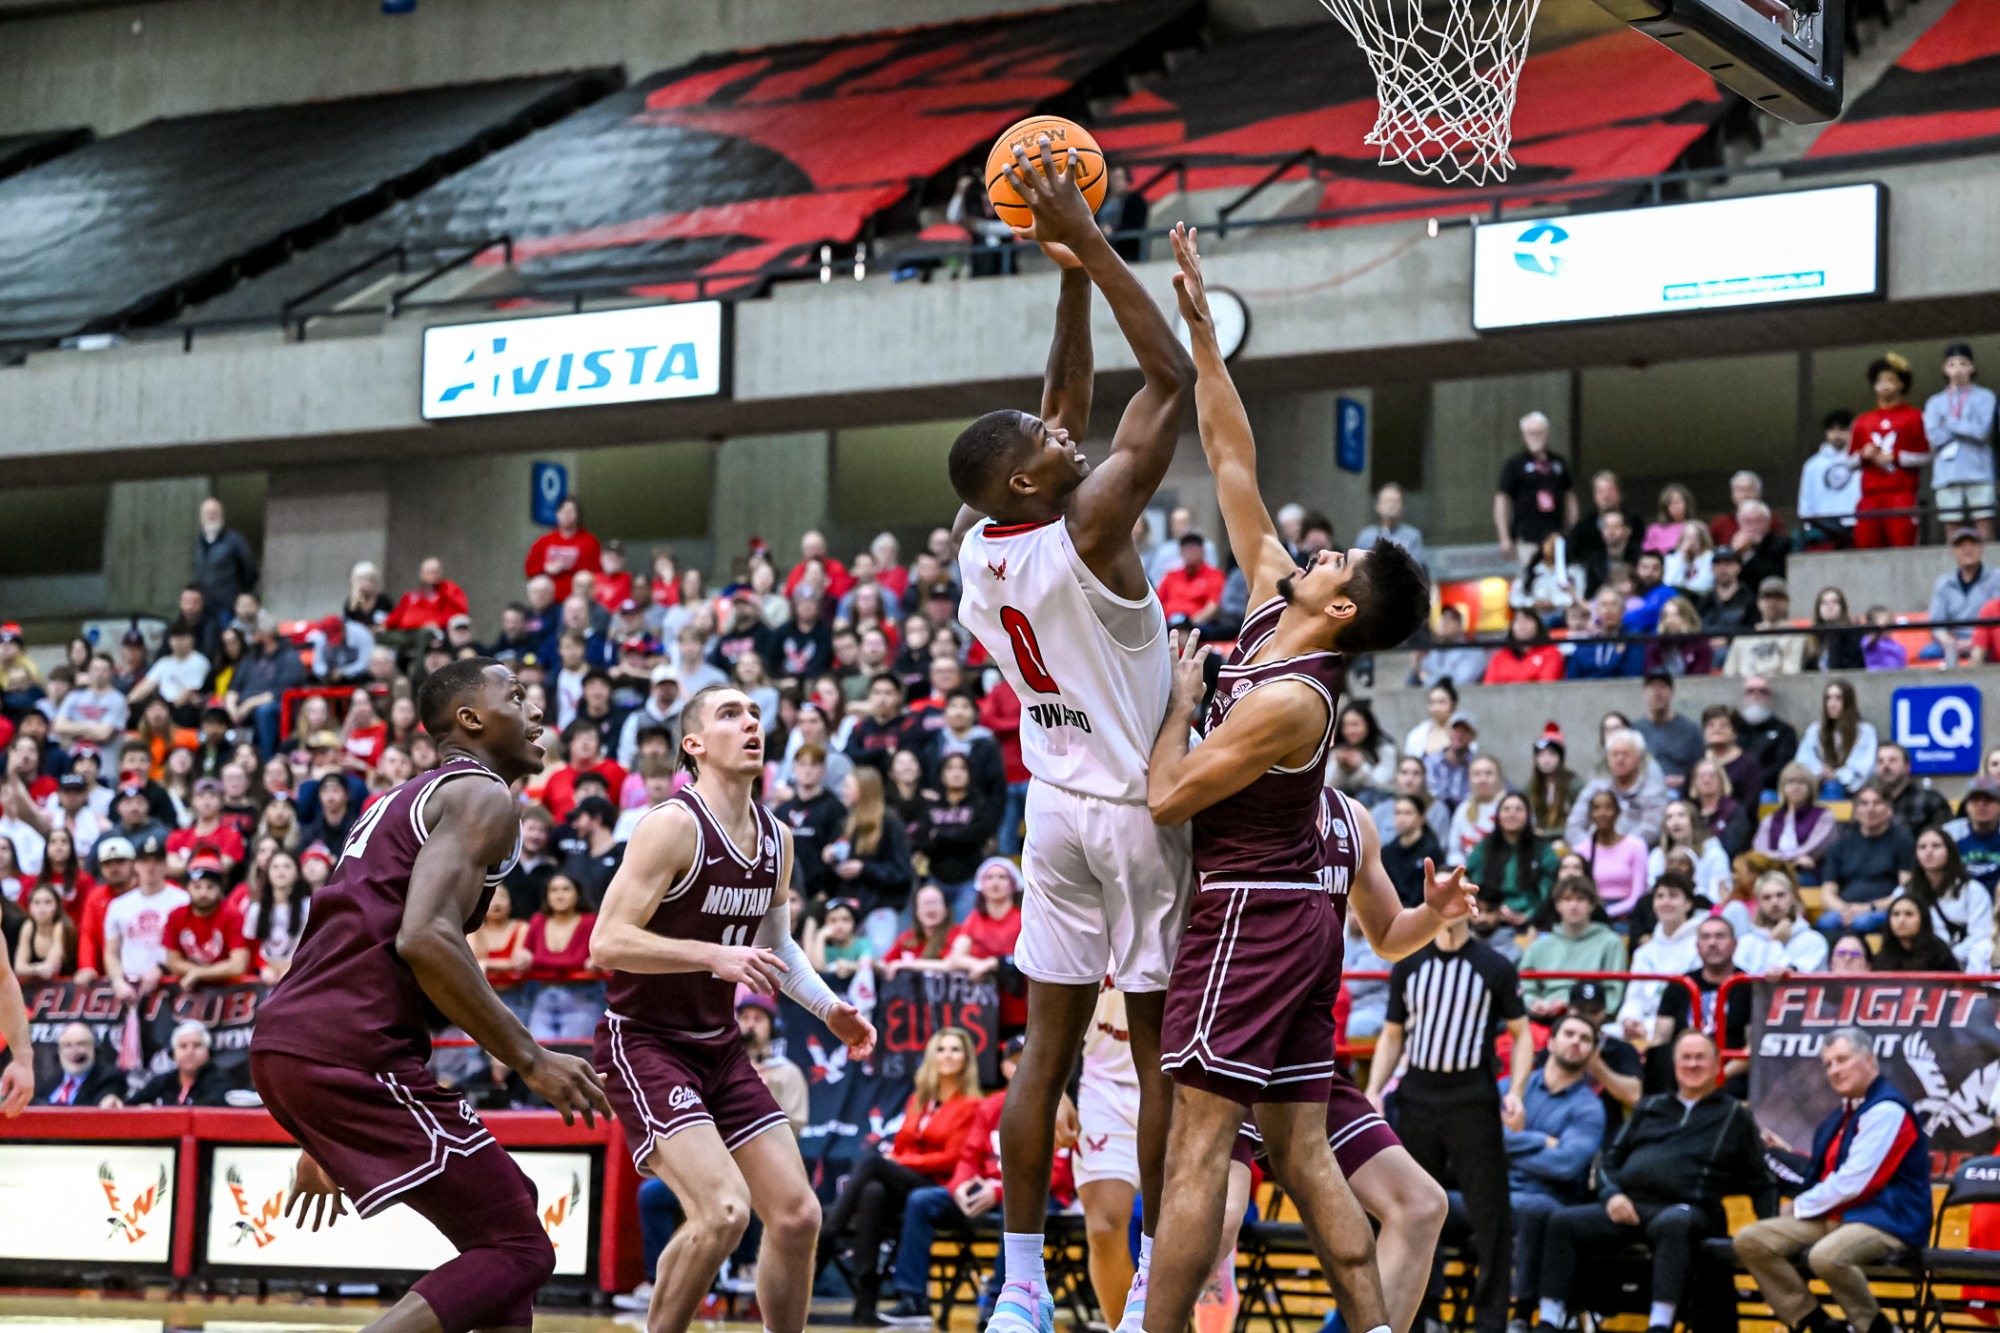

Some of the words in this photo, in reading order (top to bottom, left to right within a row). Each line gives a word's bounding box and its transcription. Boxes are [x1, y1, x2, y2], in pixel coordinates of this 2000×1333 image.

[1000, 606, 1061, 696] 0
[1897, 695, 1974, 750] LQ
[1766, 986, 1988, 1029] FLIGHT
